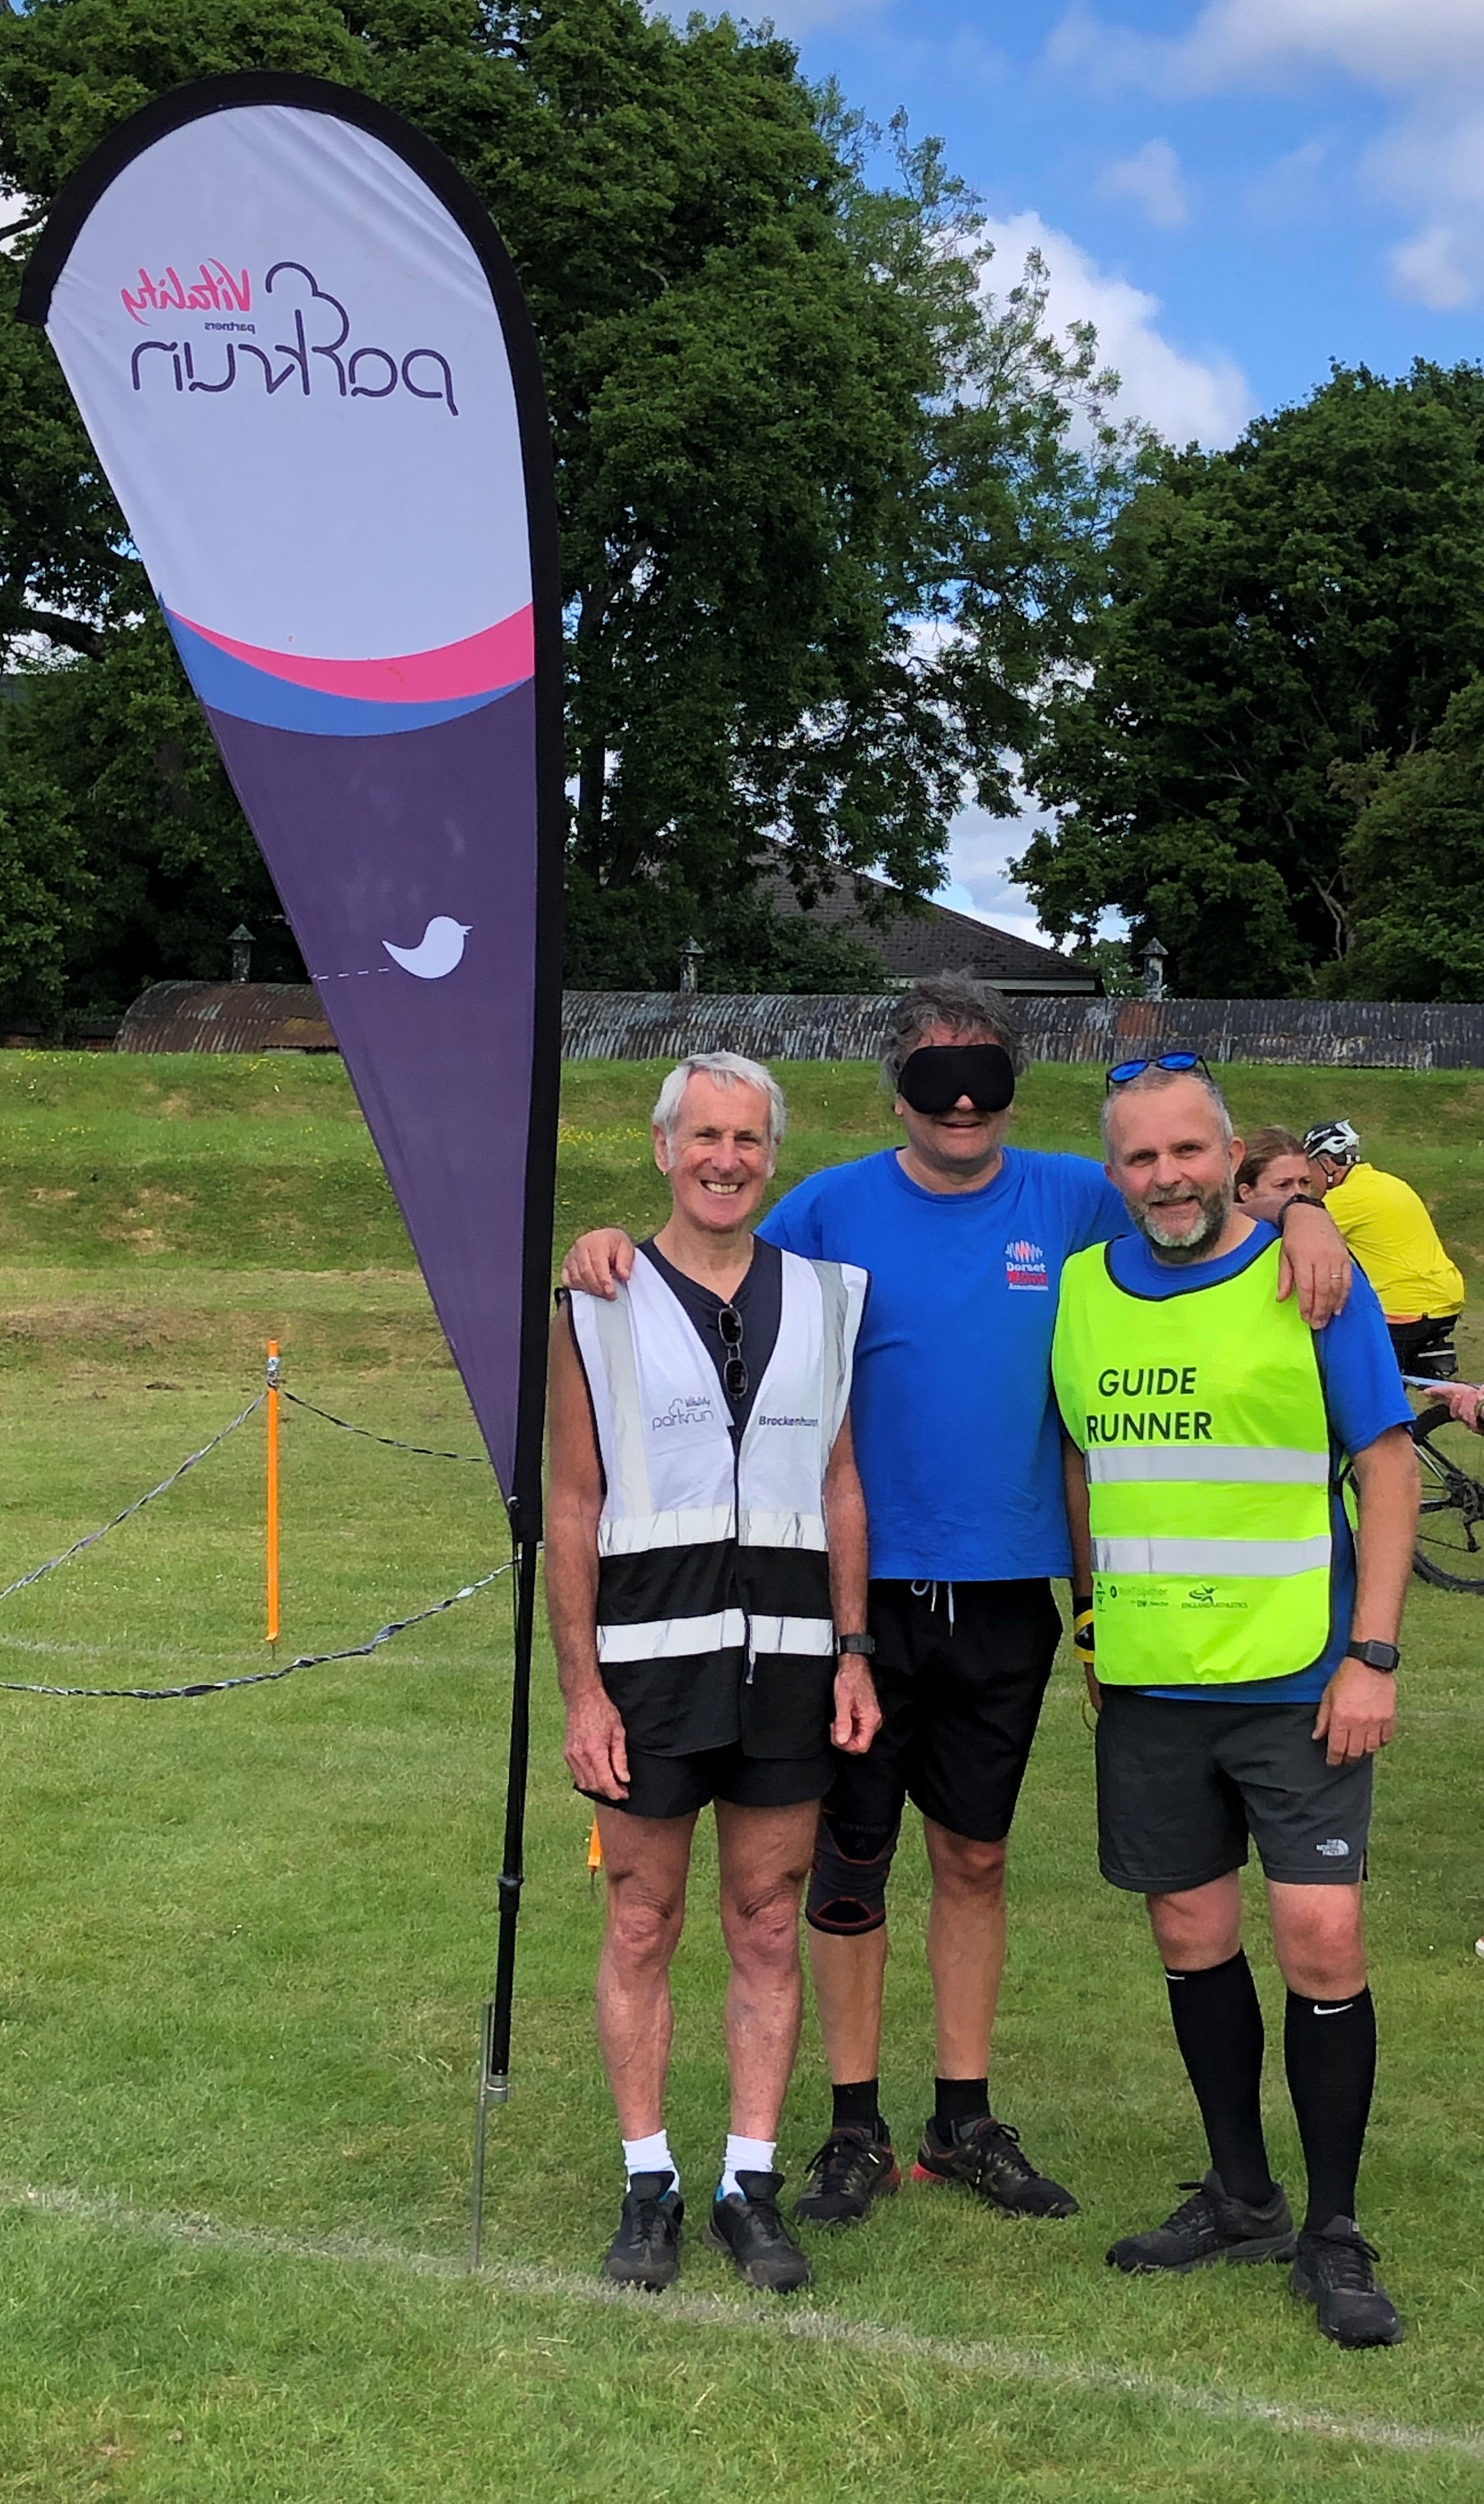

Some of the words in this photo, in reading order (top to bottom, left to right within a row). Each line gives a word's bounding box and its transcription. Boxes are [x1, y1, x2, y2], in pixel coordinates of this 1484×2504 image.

[1005, 1261, 1047, 1273] Dorset
[1098, 1367, 1196, 1397] GUIDE
[652, 1398, 714, 1431] parkrun
[759, 1416, 819, 1427] Brockenht
[1086, 1412, 1213, 1443] RUNNER
